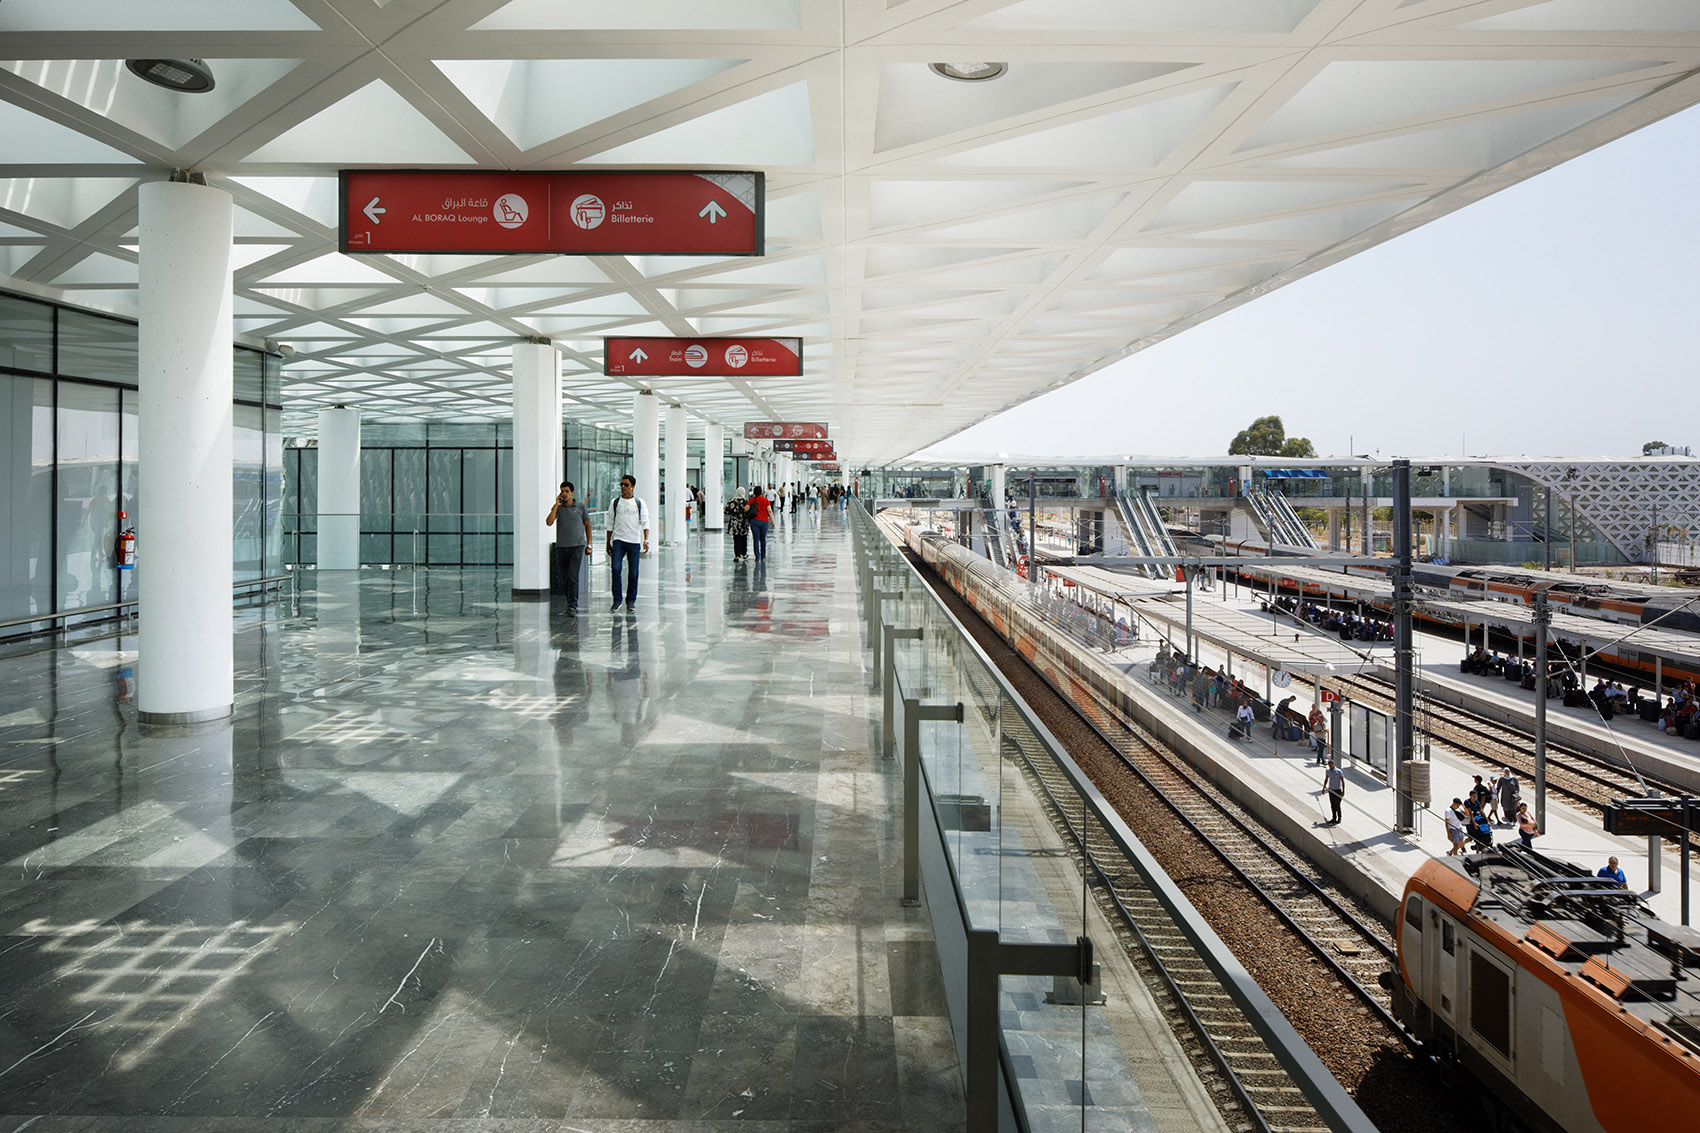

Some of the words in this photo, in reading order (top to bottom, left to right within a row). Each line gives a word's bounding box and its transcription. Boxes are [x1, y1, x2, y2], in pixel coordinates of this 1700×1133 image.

[441, 198, 466, 210] البراق
[468, 198, 488, 208] قاعة
[611, 201, 633, 212] تذاكر
[412, 214, 423, 222] AL
[425, 214, 456, 223] BORAQ
[458, 214, 488, 224] Lounge
[611, 214, 654, 223] Billetterie
[365, 231, 371, 244] 1
[1326, 692, 1334, 701] D
